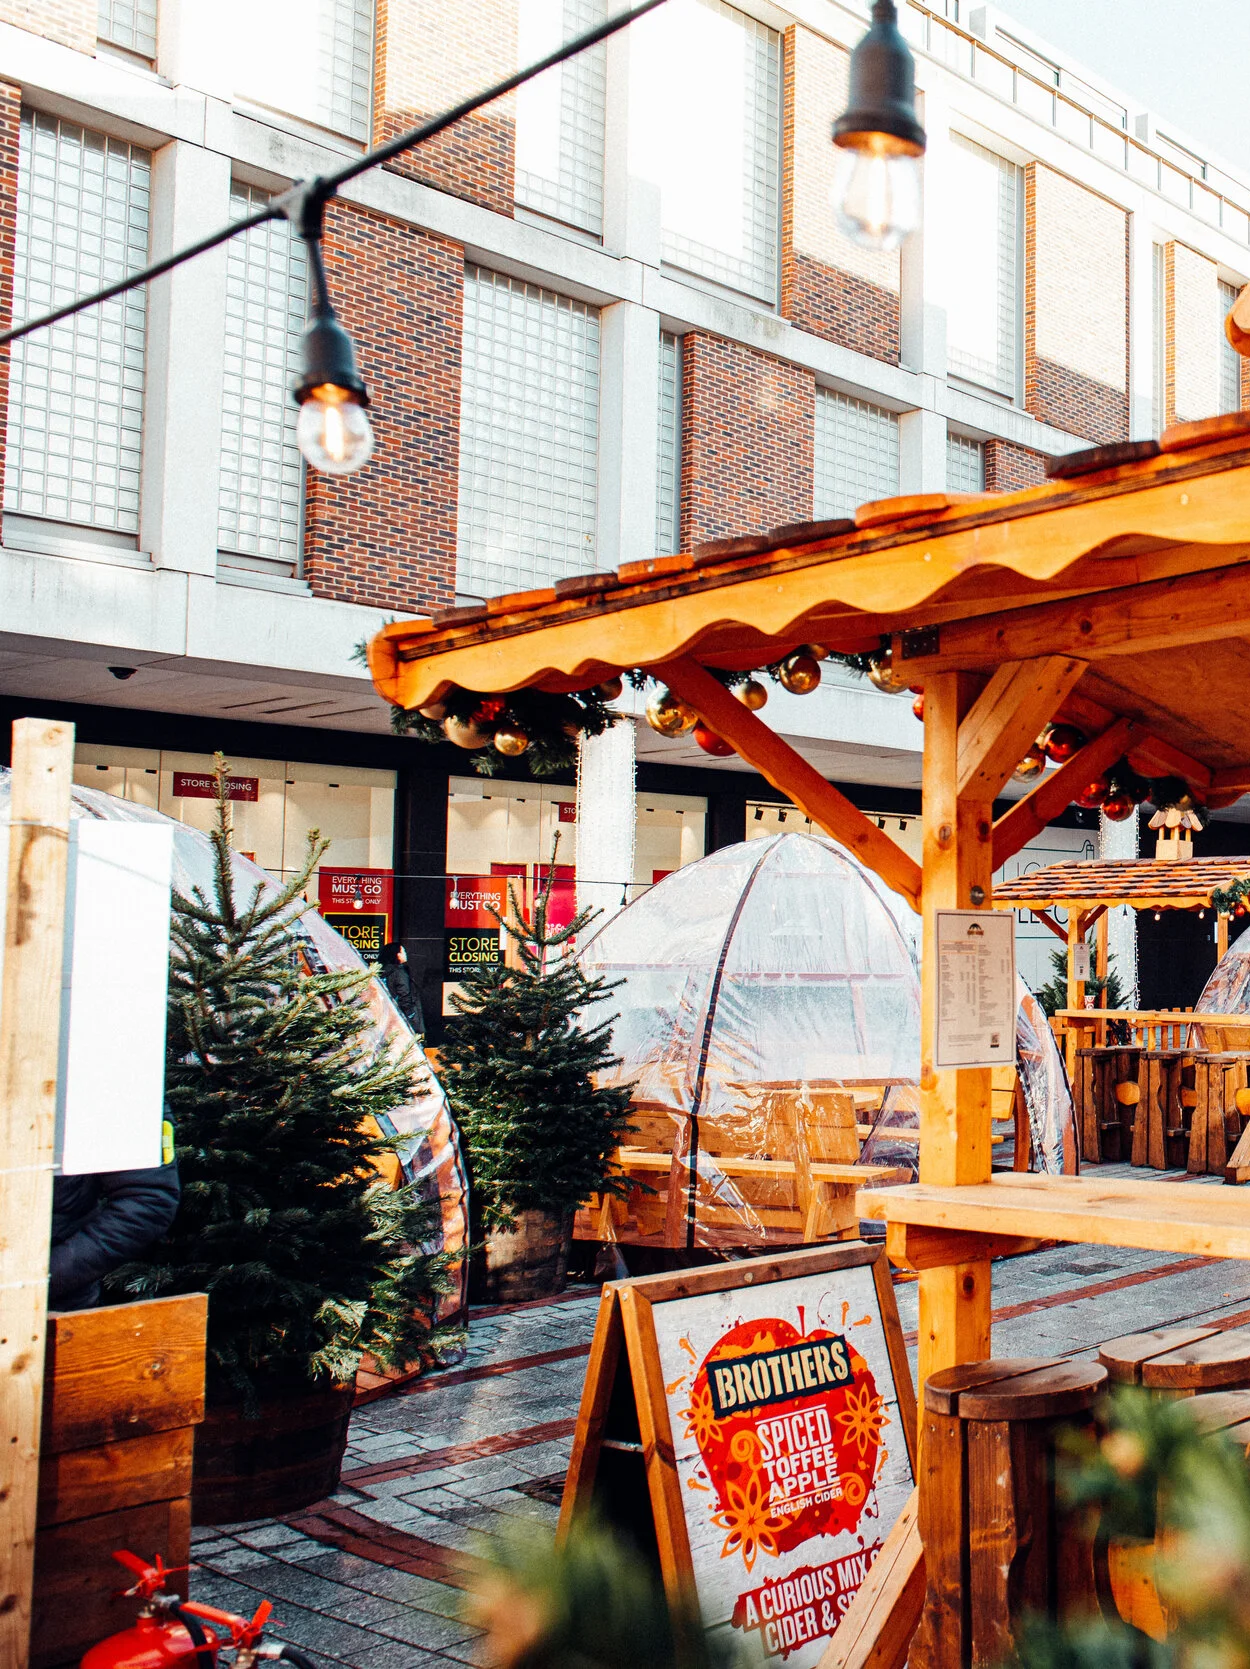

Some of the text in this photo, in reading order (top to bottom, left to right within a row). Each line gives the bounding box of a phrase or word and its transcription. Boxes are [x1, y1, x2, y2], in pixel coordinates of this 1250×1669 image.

[181, 779, 252, 791] STORE COSING
[331, 876, 382, 885] EVERYHING
[364, 884, 382, 894] GO
[449, 937, 499, 951] STORE
[449, 952, 499, 963] CLOSING
[714, 1341, 849, 1409] BROTHERS
[757, 1408, 832, 1461] SPICED
[763, 1444, 838, 1482] TOFFEE
[769, 1463, 840, 1502] APPLE
[770, 1487, 843, 1518] ENGLISH CIDER
[745, 1595, 760, 1627] A
[759, 1566, 836, 1620] CURIOUS
[836, 1553, 868, 1592] MIX
[765, 1607, 819, 1652] CIDER
[821, 1601, 837, 1630] &
